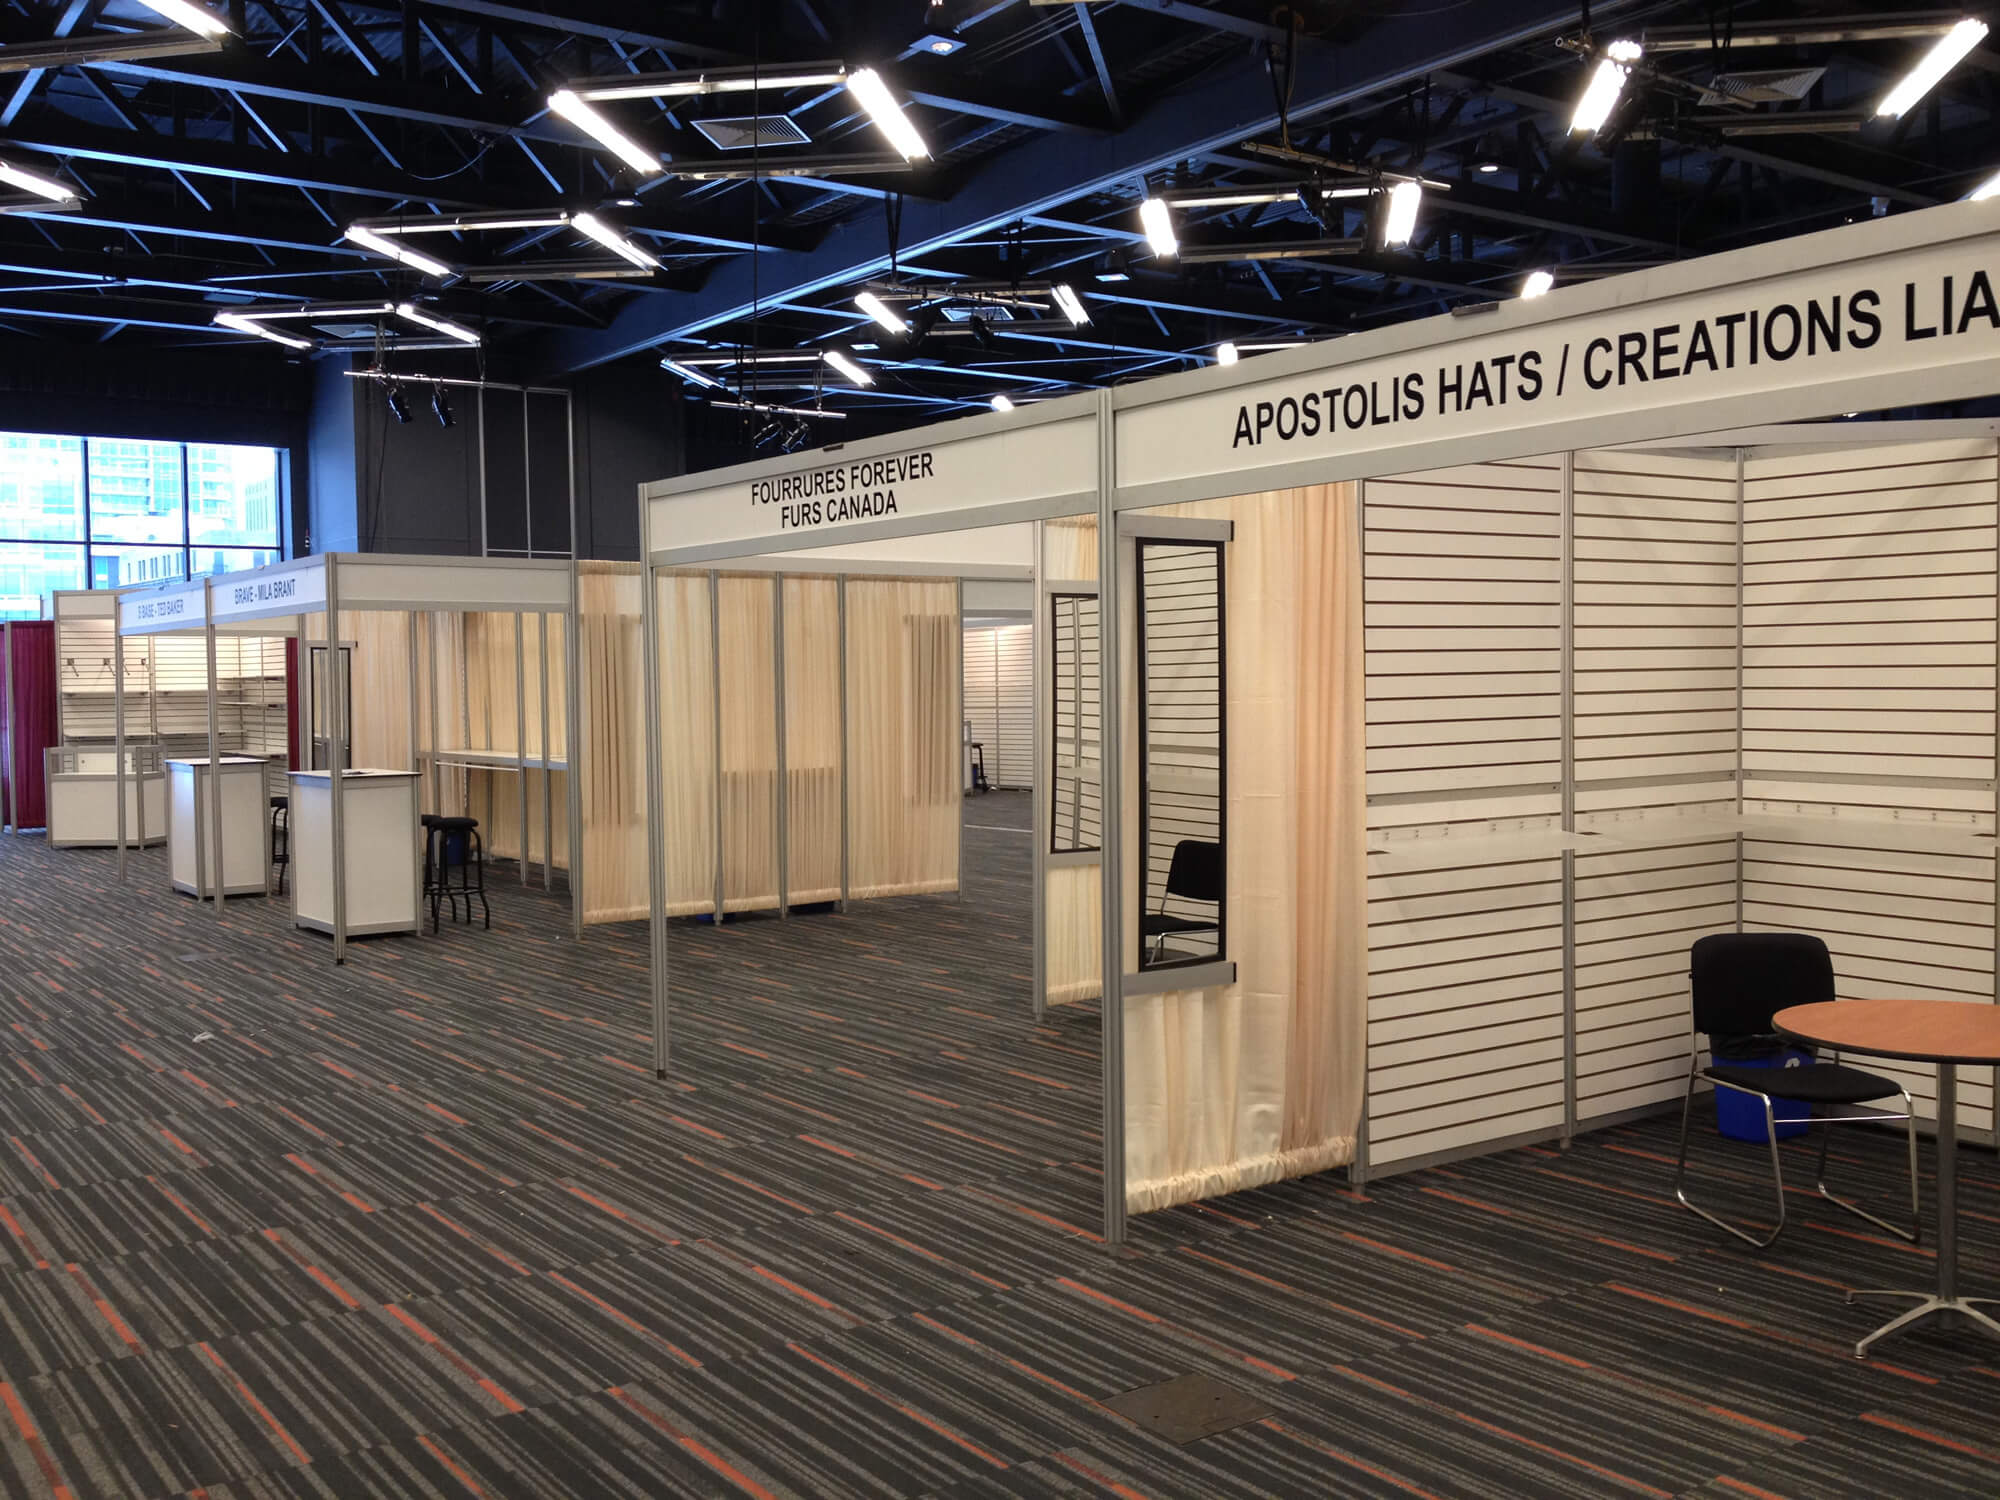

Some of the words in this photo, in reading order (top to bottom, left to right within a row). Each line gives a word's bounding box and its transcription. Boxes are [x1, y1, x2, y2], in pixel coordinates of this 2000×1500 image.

[1233, 373, 1425, 448] APOSTOLIS
[1439, 350, 1543, 415] HATS
[1556, 344, 1570, 396] /
[1584, 289, 1882, 390] CREATIONS
[1905, 270, 2000, 341] LIA
[751, 468, 846, 505] FOURRURES
[851, 452, 934, 489] FOREVER
[782, 501, 822, 528] FURS
[826, 490, 898, 522] CANADA
[157, 601, 166, 616] TED
[167, 599, 184, 615] BAKER
[234, 586, 253, 605] BRAVE
[258, 583, 273, 600] MILA
[273, 578, 296, 599] BRANT
